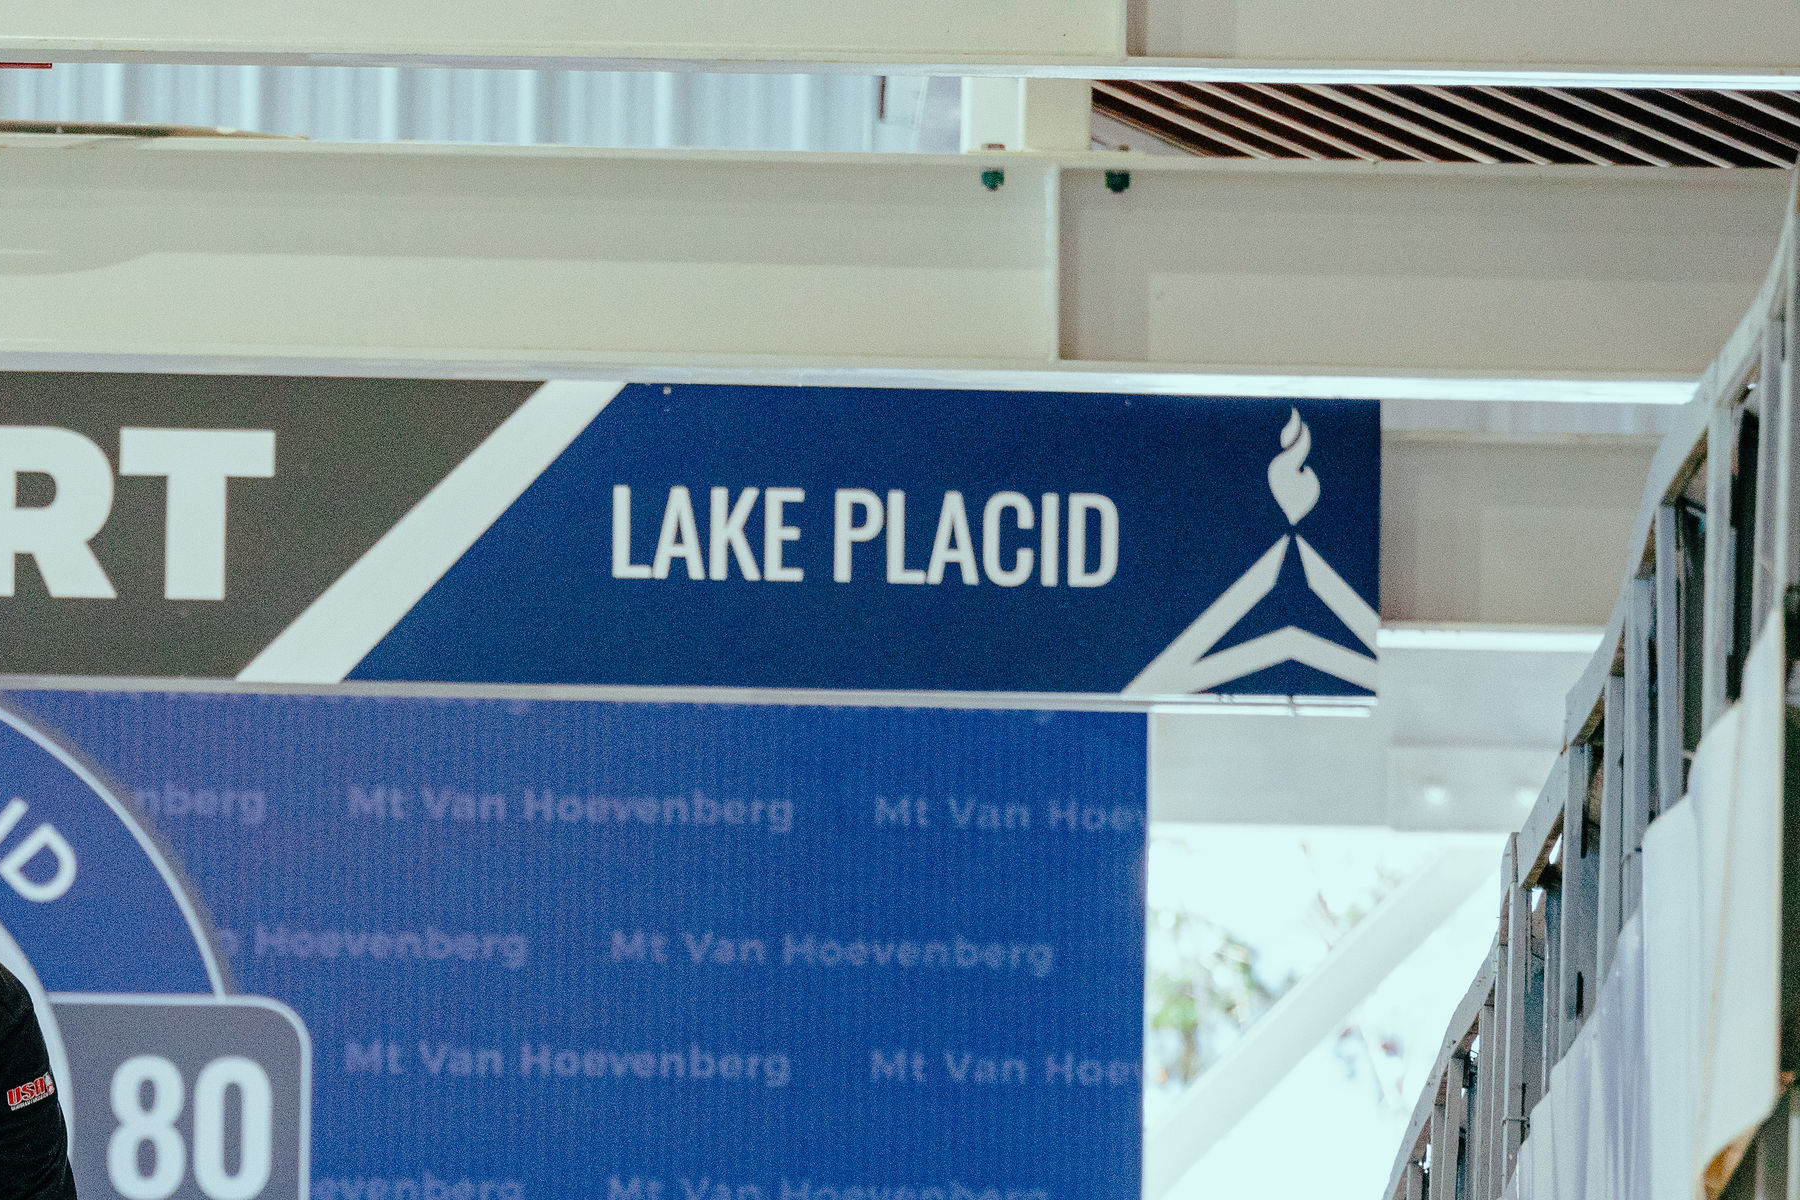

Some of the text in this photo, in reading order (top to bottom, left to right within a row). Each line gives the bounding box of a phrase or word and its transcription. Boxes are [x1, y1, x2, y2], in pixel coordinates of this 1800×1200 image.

[611, 484, 1121, 589] LAKE PLACID
[348, 785, 795, 833] Mt Van Hoevenberg
[874, 794, 931, 829] Mt
[948, 795, 1031, 830] Van
[255, 924, 528, 968] Hoevenberg
[611, 929, 1055, 977] Mt Van Hoevenberg
[345, 1040, 791, 1088] Mt Van Hoevenberg
[871, 1049, 927, 1084] Mt
[943, 1050, 1027, 1085] Van
[7, 1076, 47, 1107] USA
